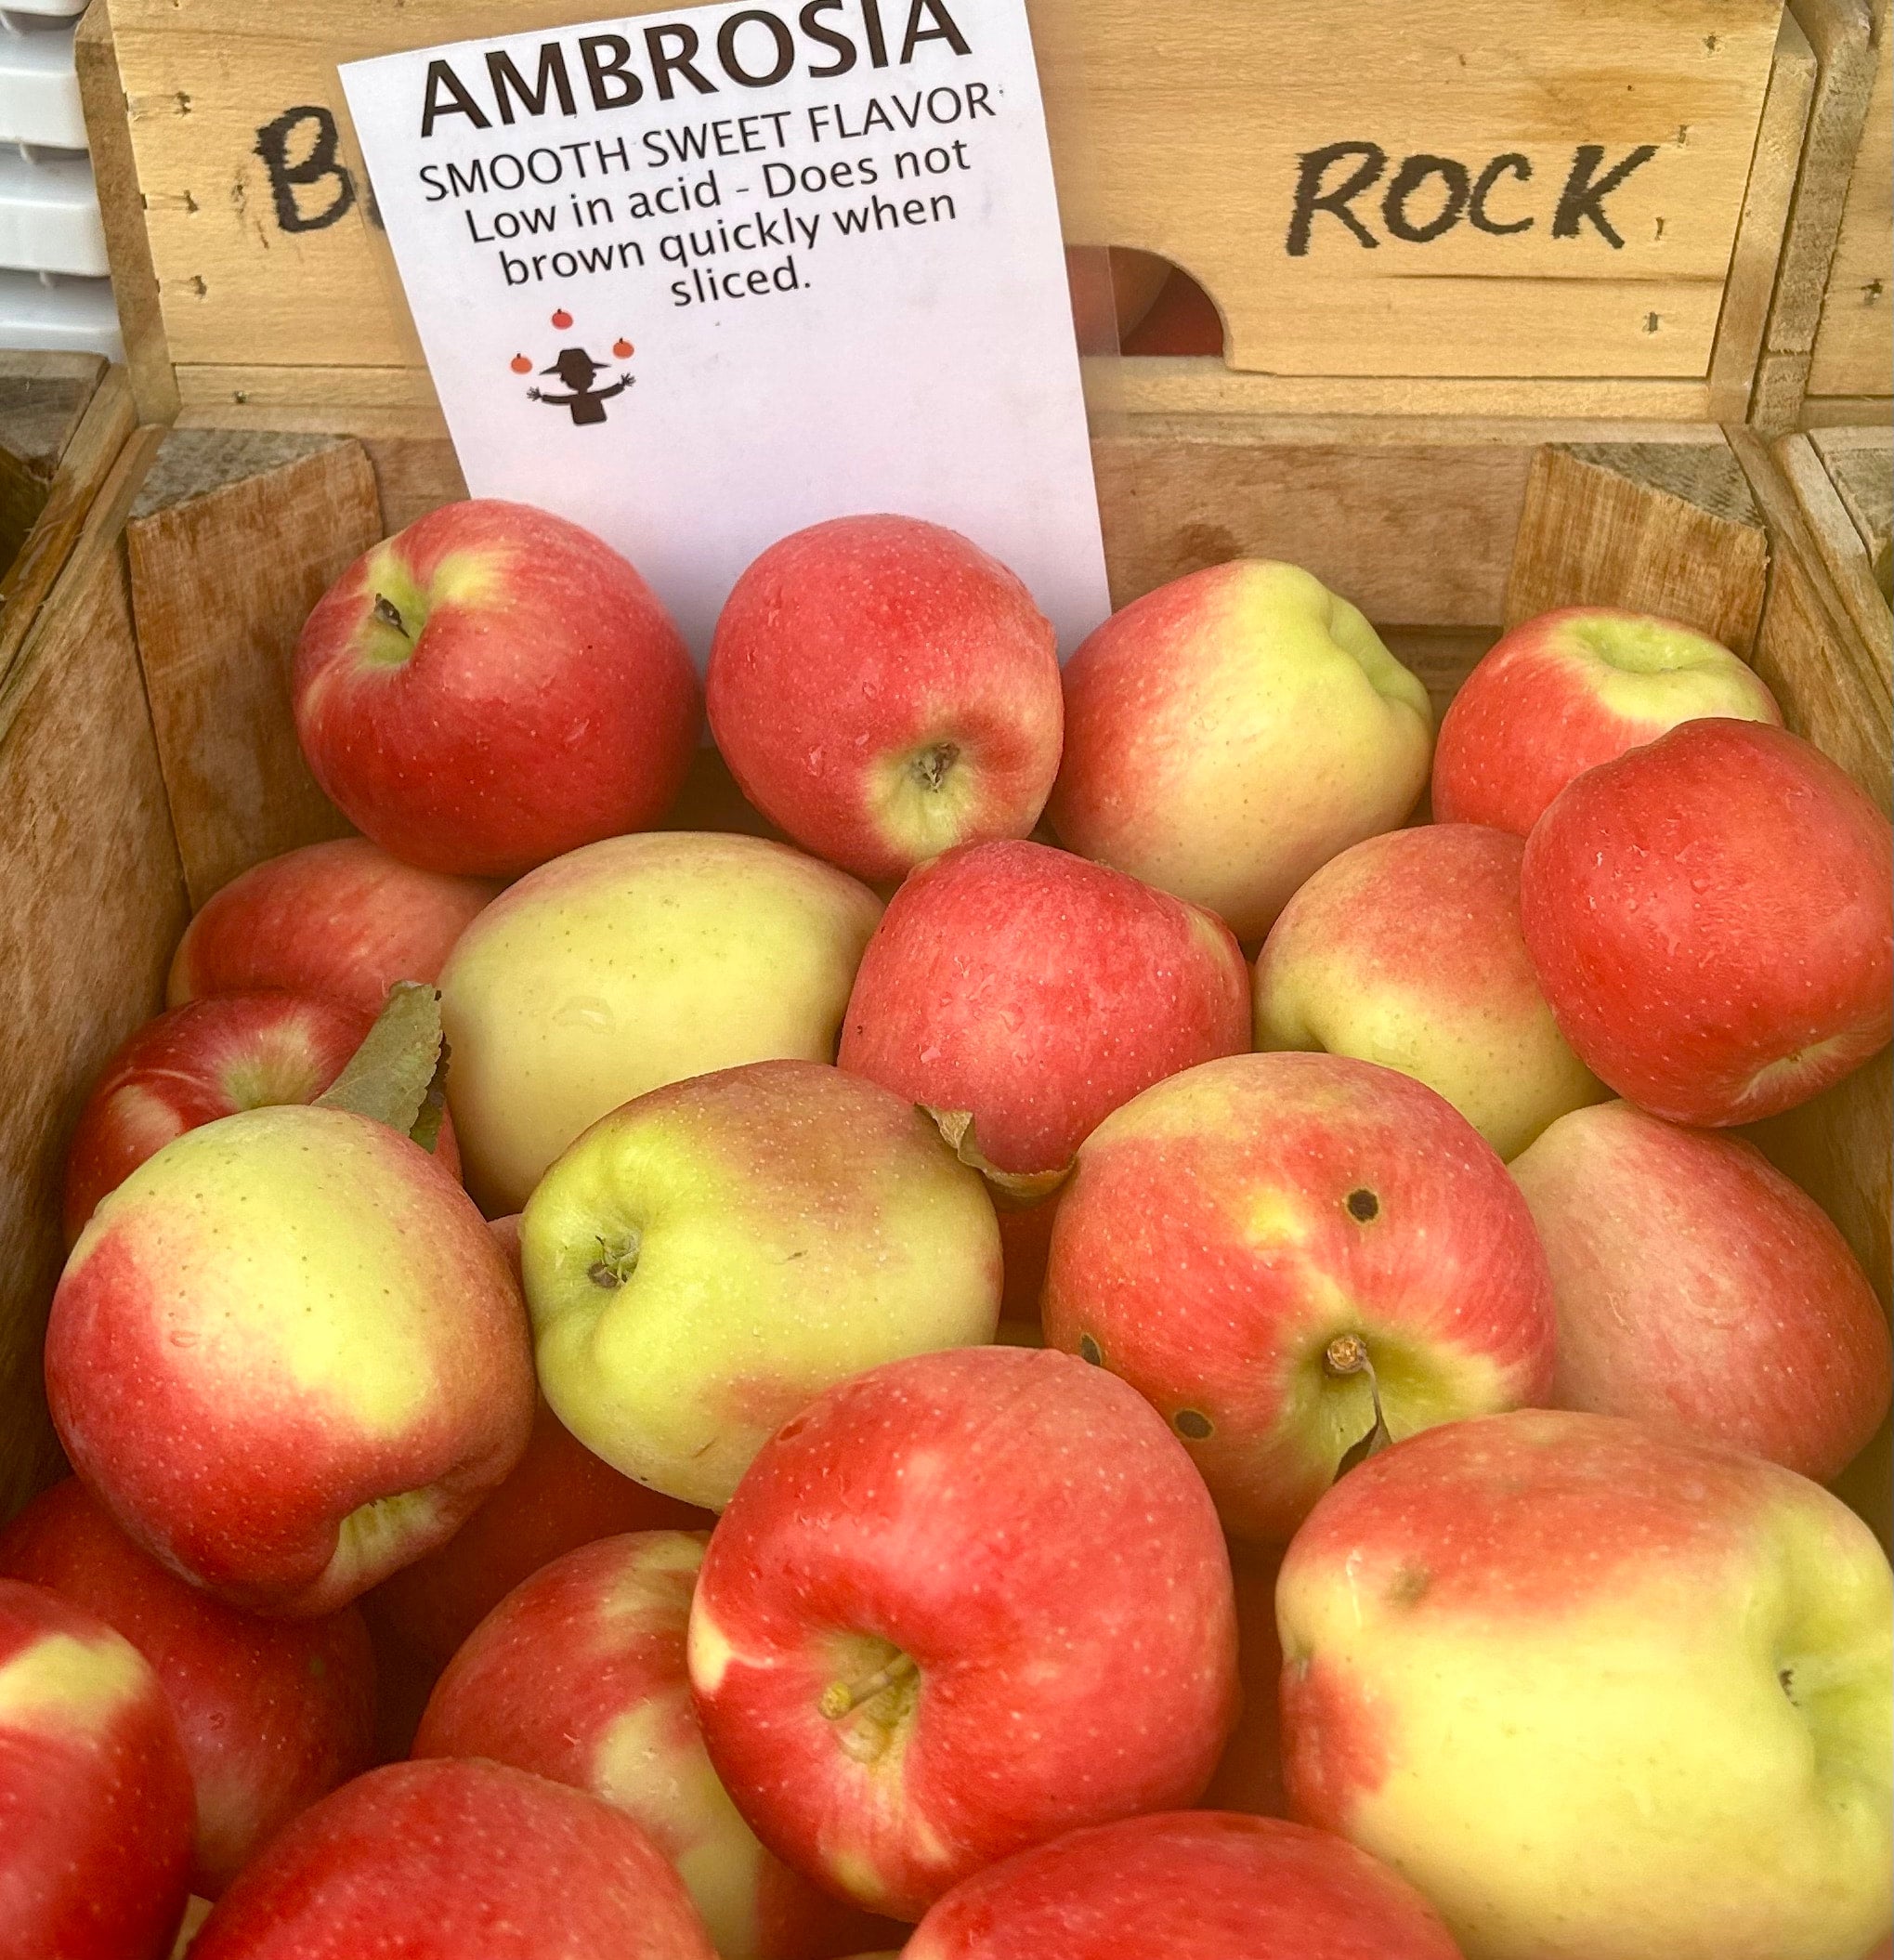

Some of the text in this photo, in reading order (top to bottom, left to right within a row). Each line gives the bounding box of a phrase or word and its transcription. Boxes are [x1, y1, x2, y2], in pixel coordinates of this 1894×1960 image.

[422, 0, 972, 137] AMBROSIA
[419, 82, 996, 203] SMOOTH SWEET FLAVOR
[465, 205, 555, 243] Low
[570, 193, 614, 228] in
[629, 169, 721, 219] acid
[762, 158, 878, 199] Does
[895, 139, 971, 179] not
[499, 194, 956, 286] brown quickly when
[1284, 140, 1660, 256] ROCK
[671, 255, 812, 307] sliced.
